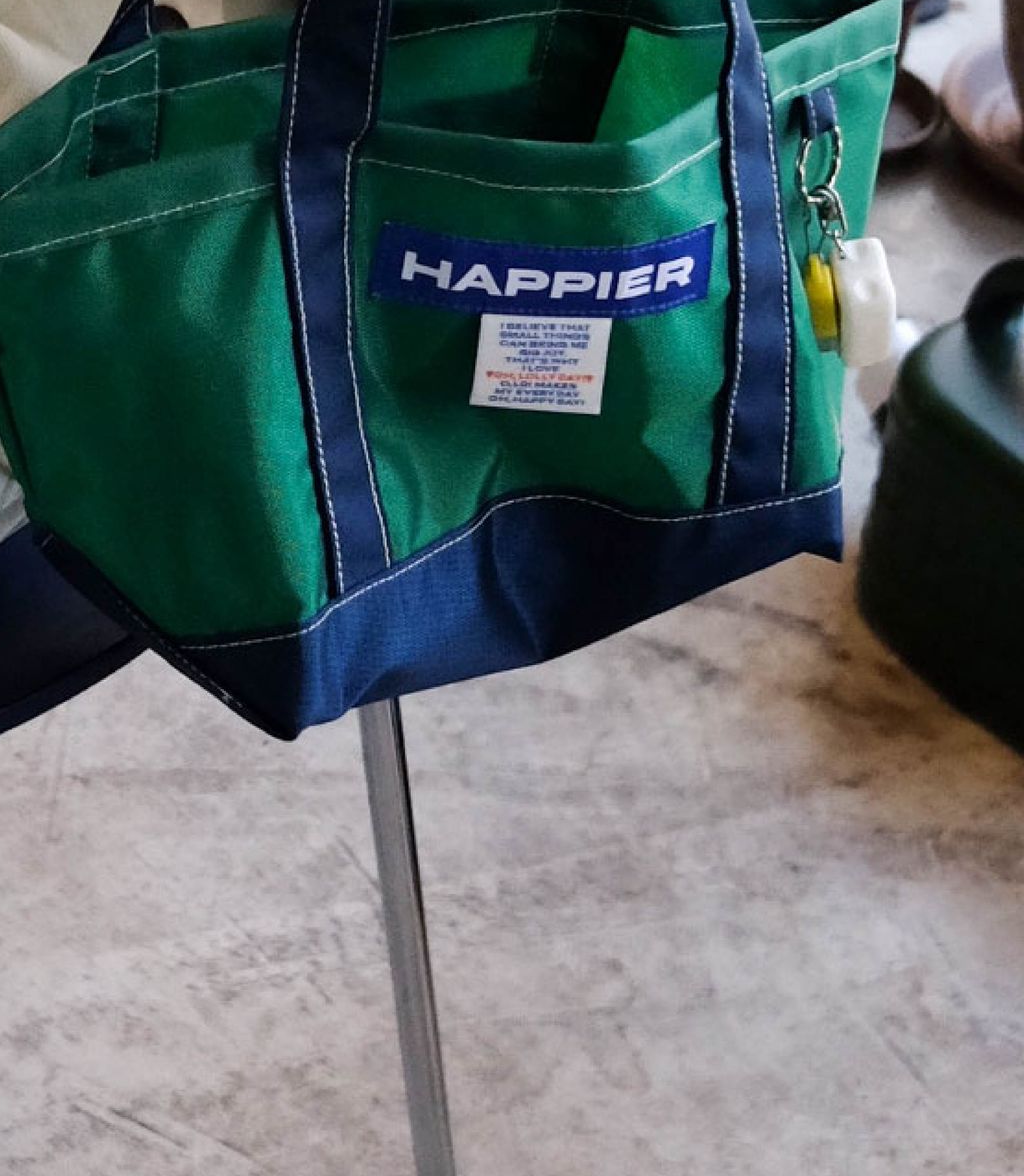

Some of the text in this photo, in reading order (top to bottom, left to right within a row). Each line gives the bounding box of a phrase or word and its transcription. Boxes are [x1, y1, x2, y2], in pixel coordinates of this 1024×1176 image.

[400, 250, 695, 301] HAPPIER
[506, 323, 556, 331] BELIEVE
[561, 324, 591, 332] THAT
[499, 331, 591, 341] SMALL THINGS
[499, 341, 589, 349] CAN BRING ME
